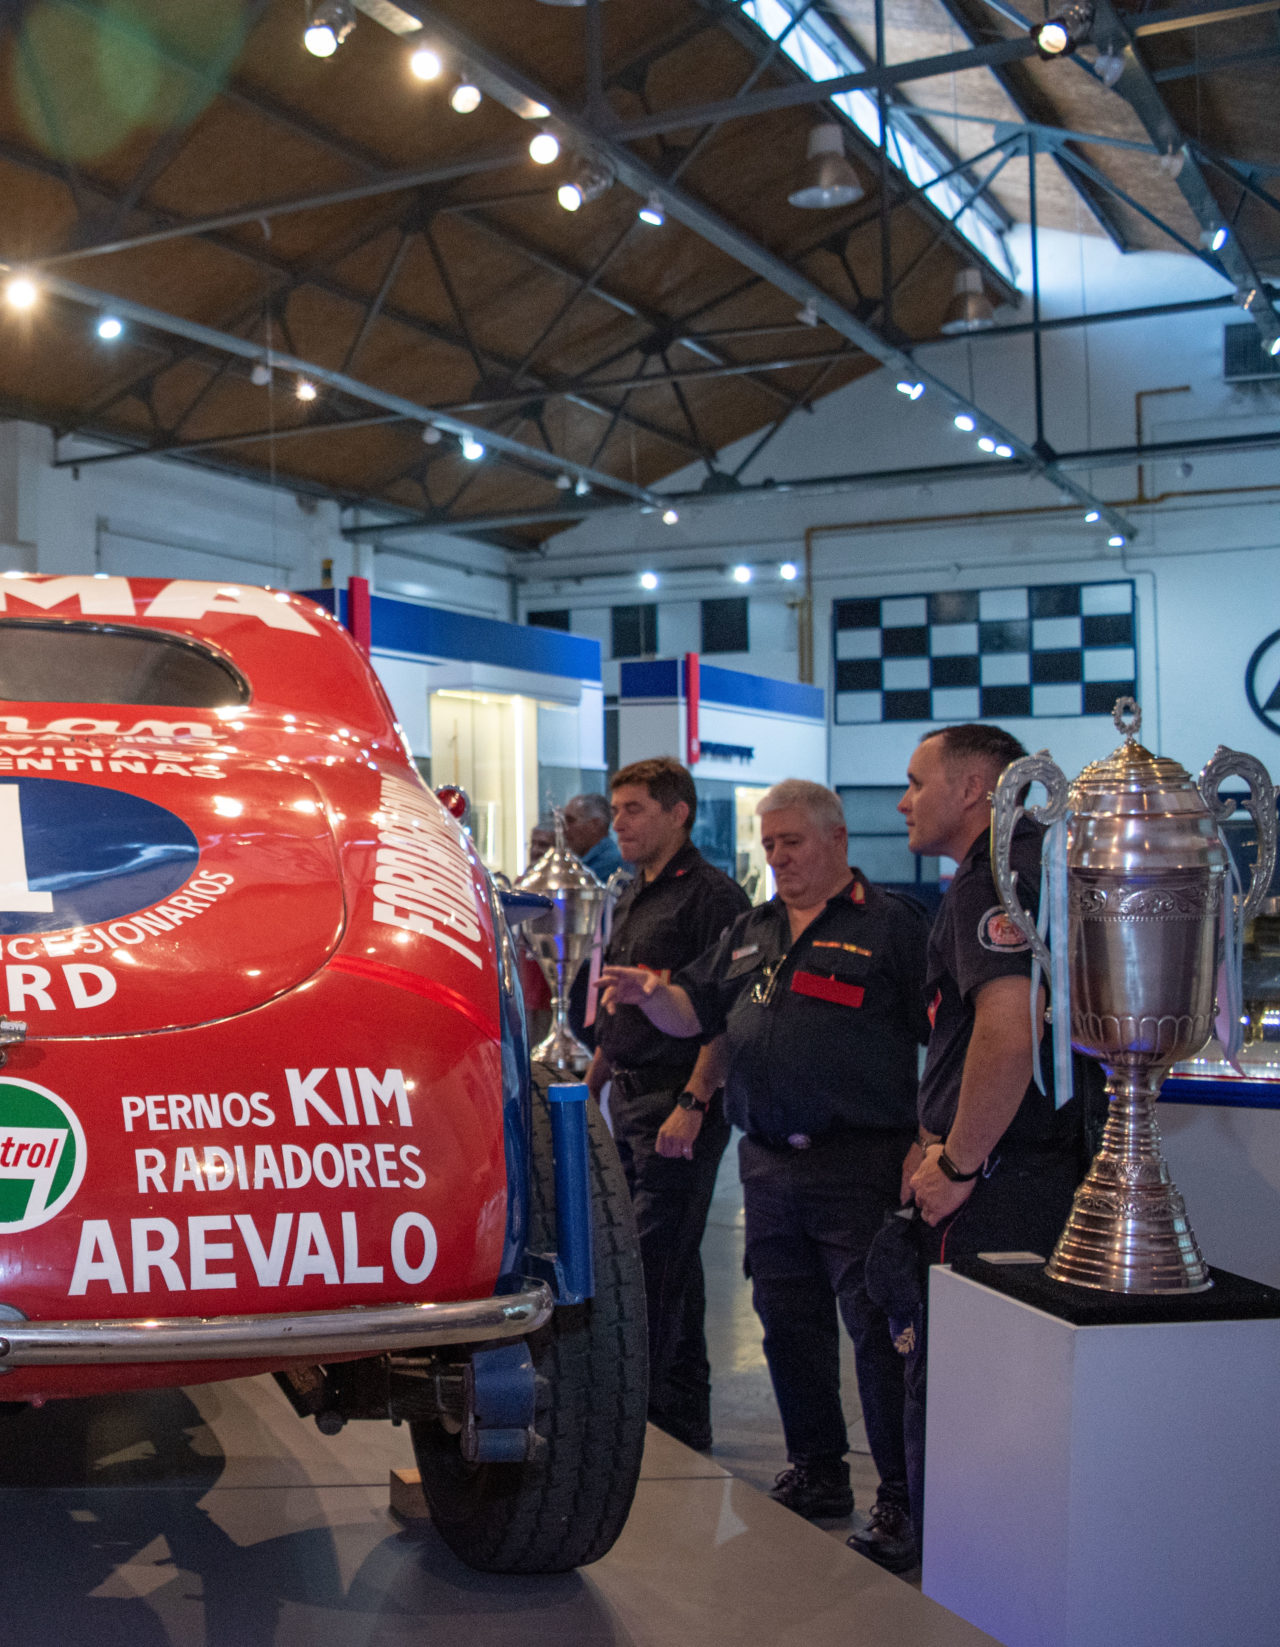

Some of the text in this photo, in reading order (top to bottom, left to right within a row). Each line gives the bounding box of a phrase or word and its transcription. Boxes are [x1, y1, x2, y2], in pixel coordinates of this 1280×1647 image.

[373, 848, 483, 971] FORD
[121, 1067, 414, 1132] PERNOS KIM
[134, 1142, 428, 1195] RADIADORES
[68, 1210, 438, 1297] AREVALO
